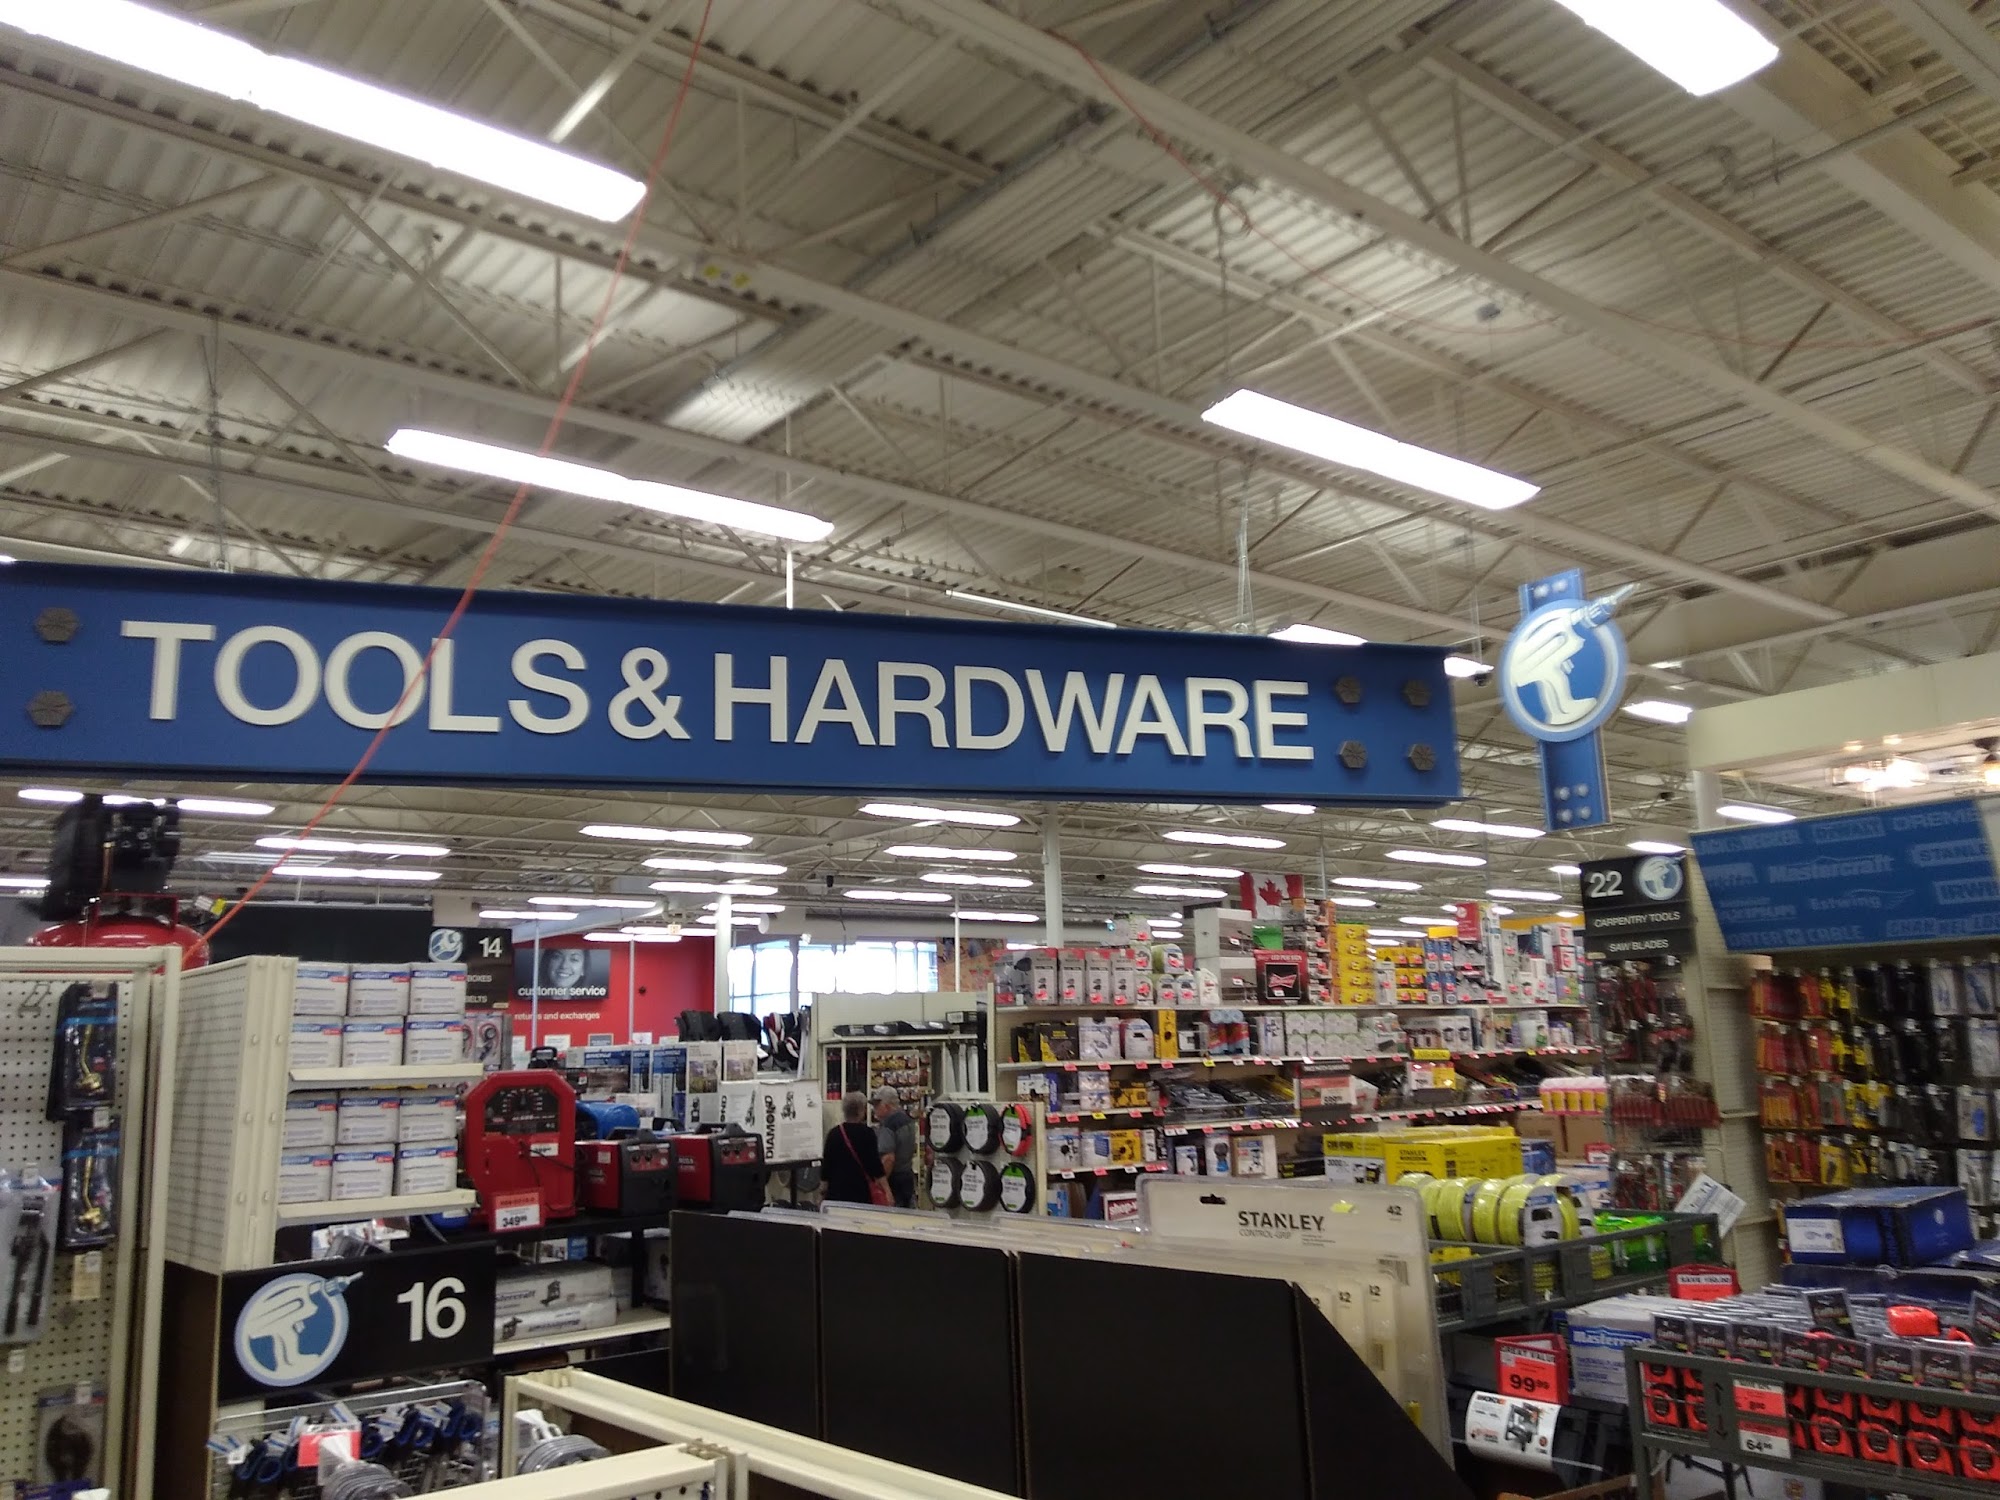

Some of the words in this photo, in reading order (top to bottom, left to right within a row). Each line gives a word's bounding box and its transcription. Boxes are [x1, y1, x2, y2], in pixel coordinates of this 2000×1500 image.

[121, 620, 589, 734] TOOLS
[607, 646, 691, 740] &
[714, 652, 1314, 760] HARDWARE
[1919, 842, 1989, 863] STANLE
[1768, 855, 1894, 884] Mastercraft
[1590, 870, 1624, 898] 22
[1594, 914, 1647, 927] CARPENTRY
[1649, 911, 1680, 922] TOOLS
[479, 937, 503, 958] 14
[1609, 942, 1630, 952] SAW
[1632, 939, 1669, 951] BLADES
[569, 985, 607, 997] service
[543, 1011, 558, 1020] and
[560, 1011, 601, 1021] exchanges
[1238, 1210, 1325, 1232] STANLEY
[1387, 1205, 1402, 1217] 42
[397, 1276, 466, 1342] 16
